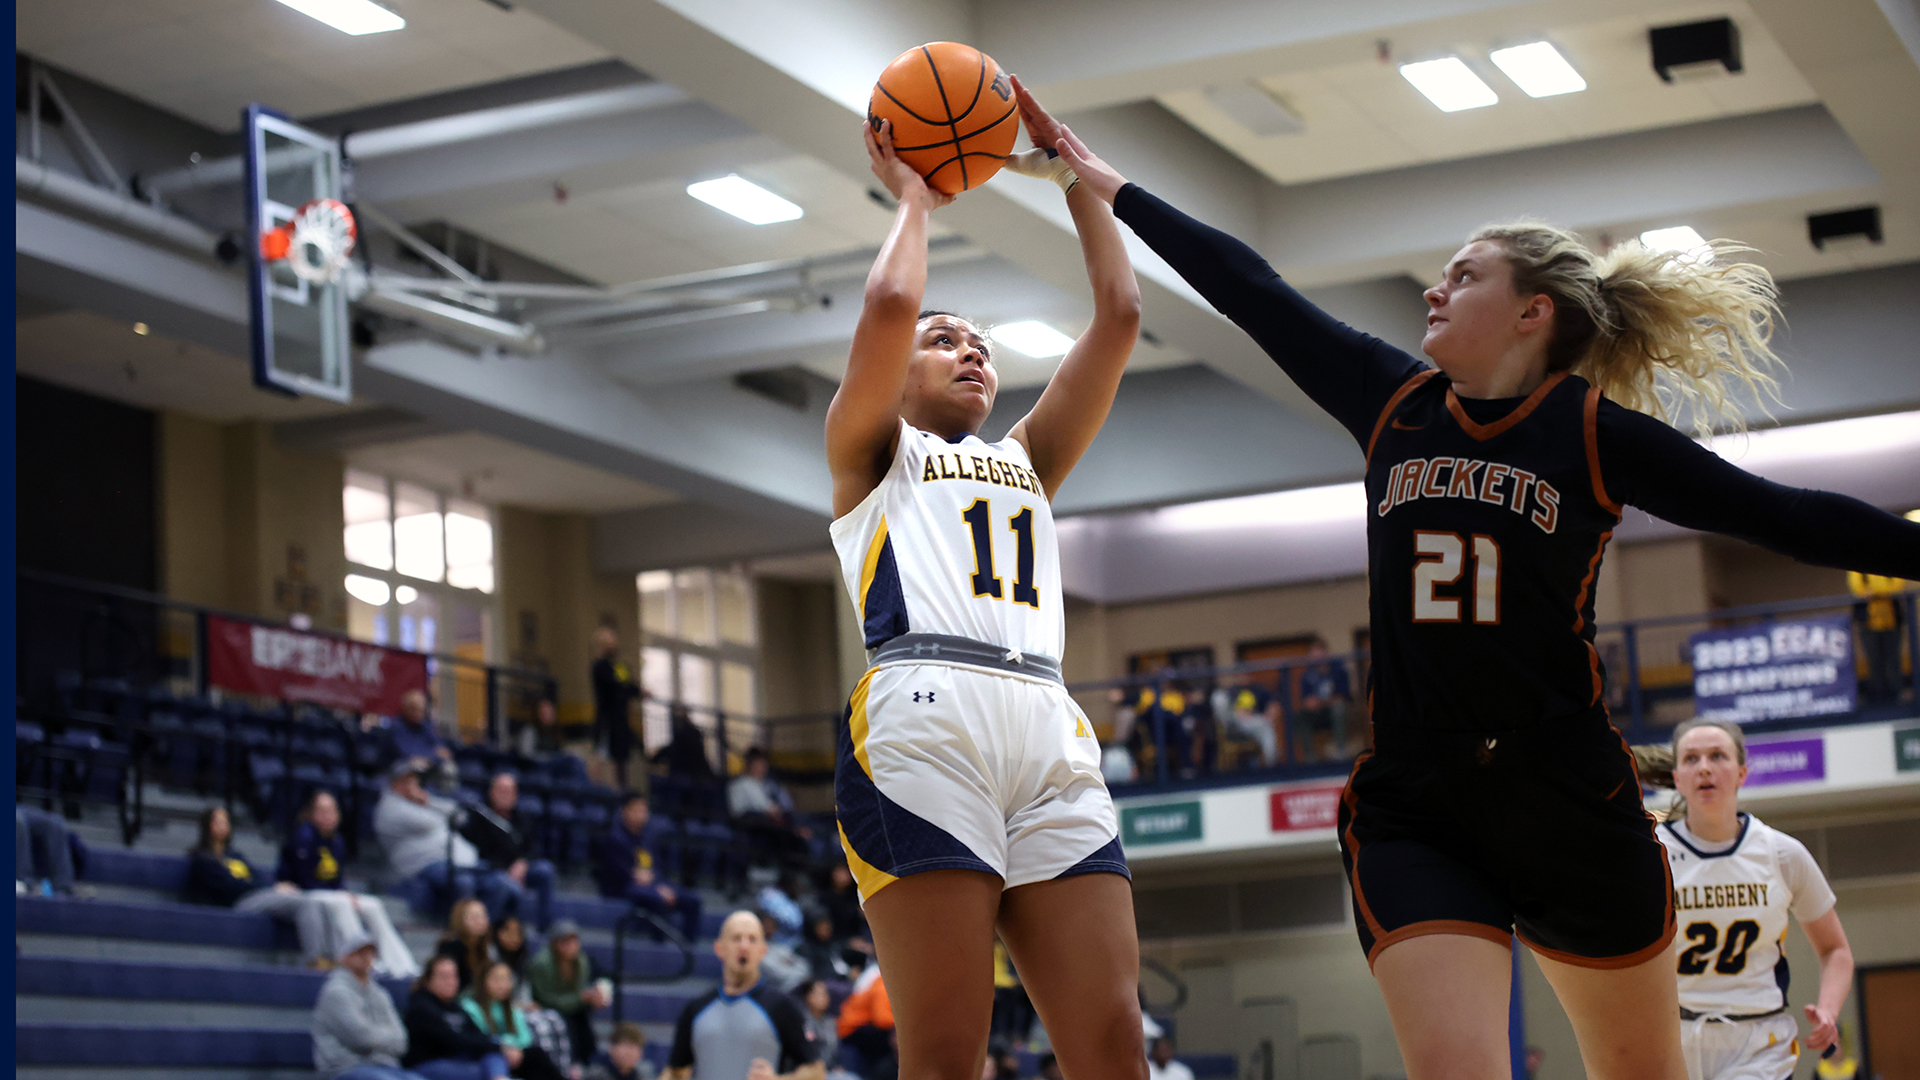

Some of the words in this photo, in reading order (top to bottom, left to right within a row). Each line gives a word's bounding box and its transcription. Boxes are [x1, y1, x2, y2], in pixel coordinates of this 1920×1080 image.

[923, 453, 1047, 503] ALLEGHEN
[1378, 456, 1561, 535] JACKETS
[960, 496, 1041, 611] 11
[1411, 528, 1503, 626] 21
[1673, 883, 1769, 911] ALLEGHENY
[1676, 918, 1762, 976] 20
